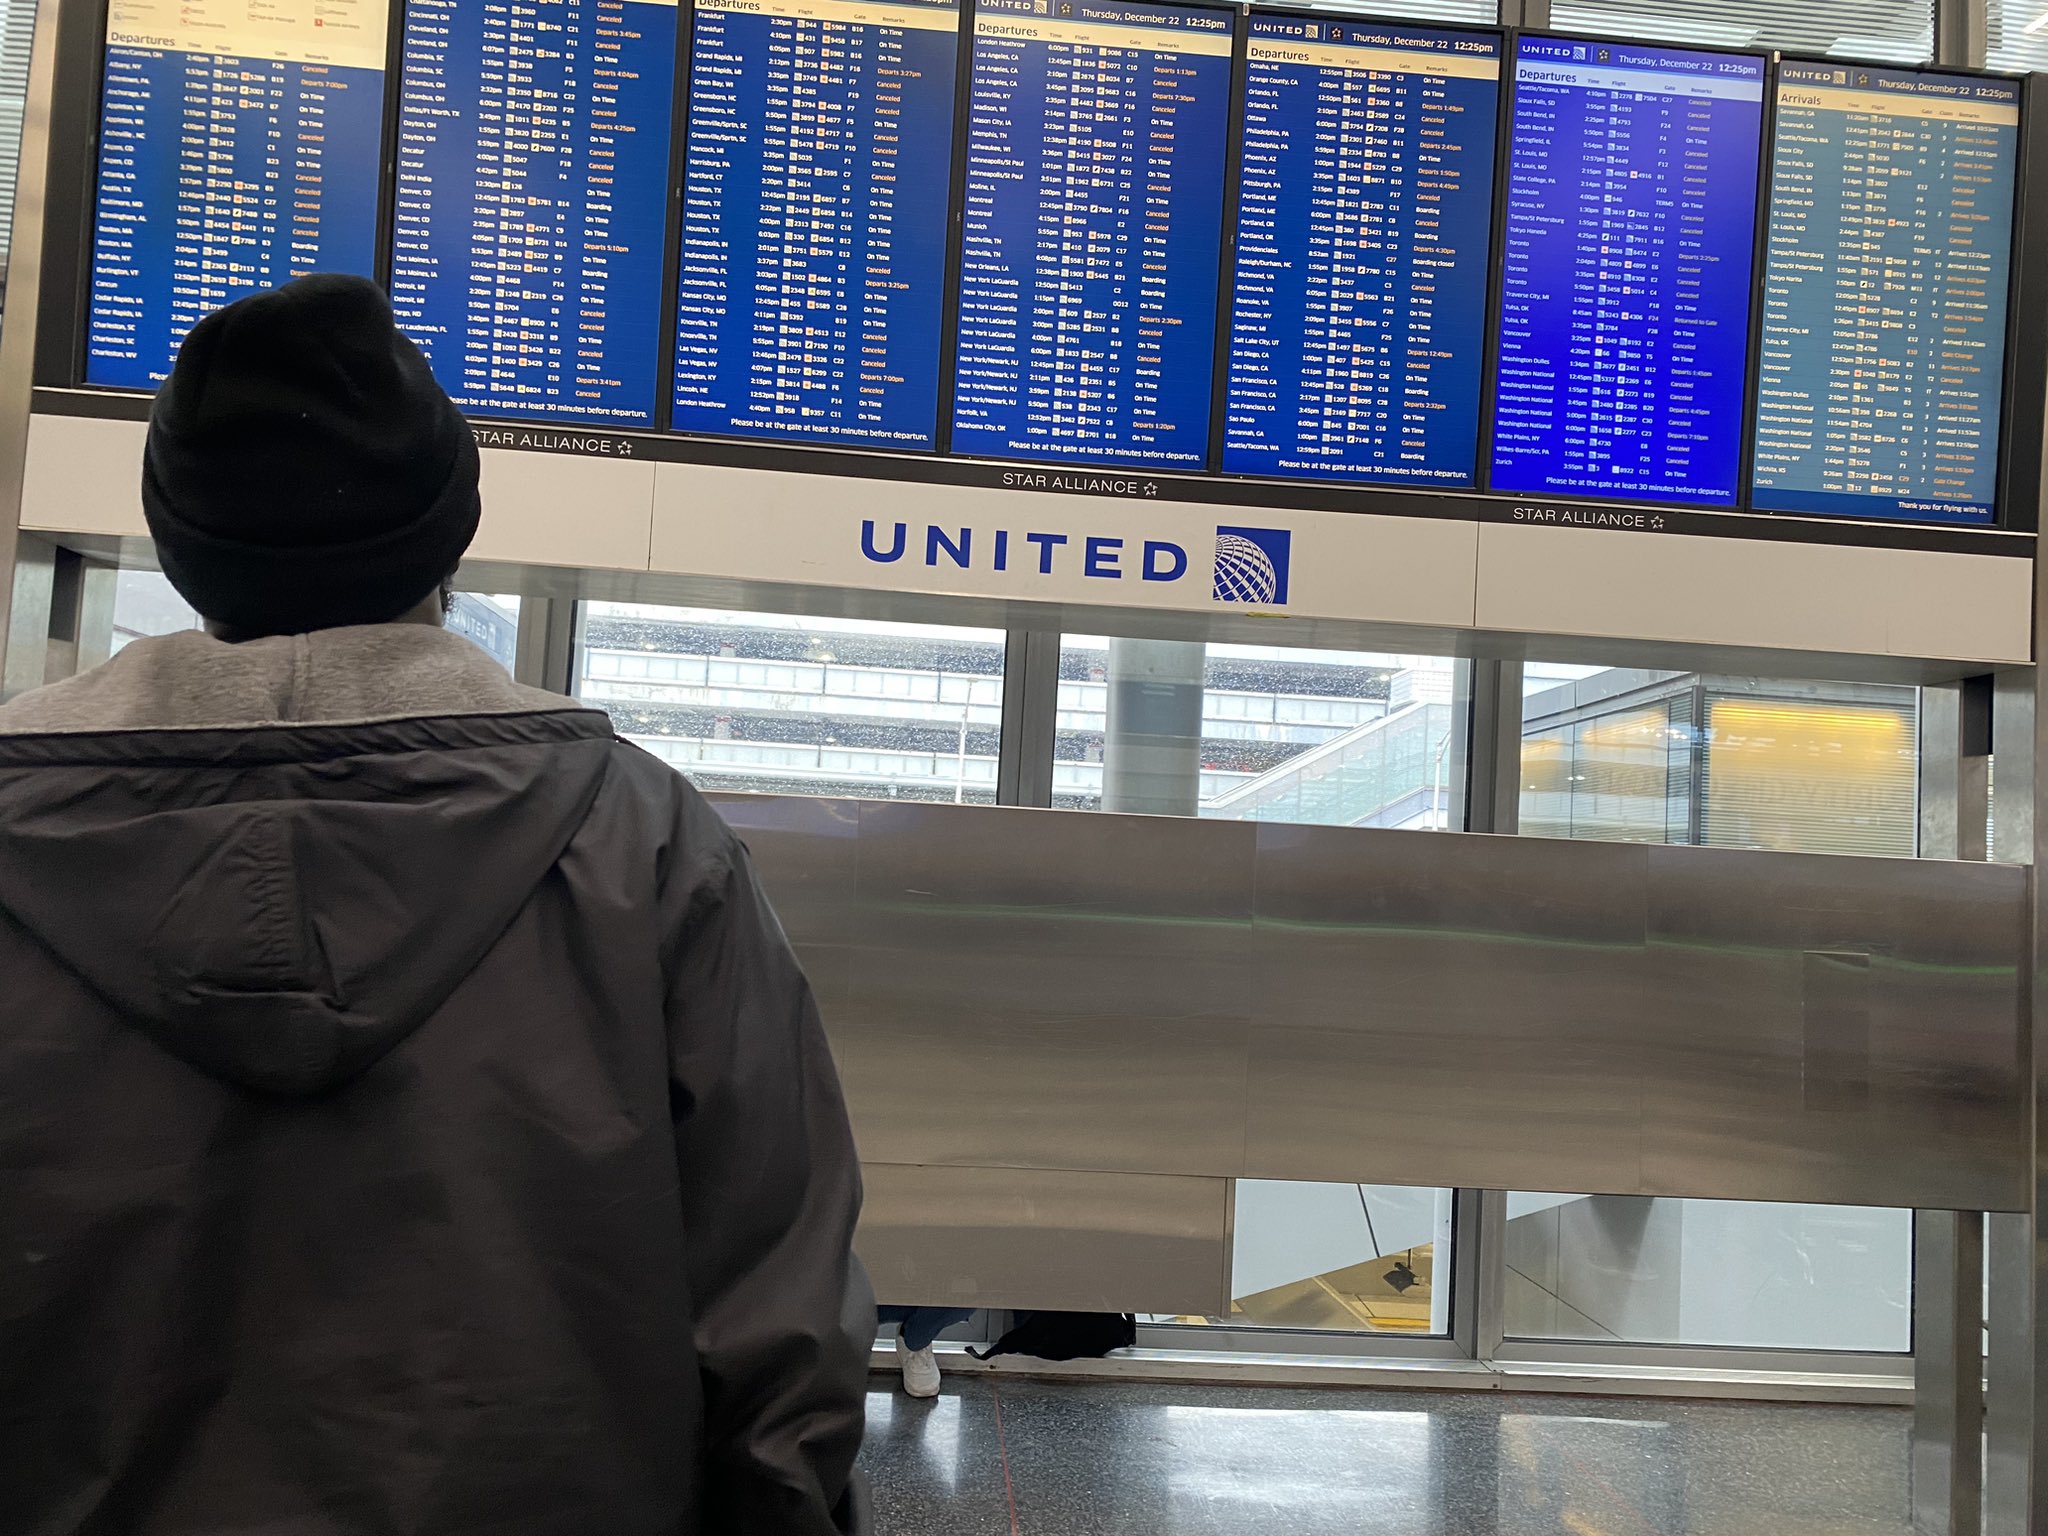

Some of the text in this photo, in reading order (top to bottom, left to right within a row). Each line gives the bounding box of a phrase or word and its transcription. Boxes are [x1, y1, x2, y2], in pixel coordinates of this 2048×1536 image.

[981, 0, 1031, 10] UNITED
[697, 11, 725, 20] Frankfurt
[1081, 8, 1225, 29] Thursday, December 22 12:25pm
[978, 22, 1038, 37] Departures
[1253, 23, 1303, 34] UNITED
[111, 32, 175, 47] Departures
[1351, 32, 1493, 53] Thursday, December 22 12:25pm
[1251, 47, 1310, 61] Departures
[1522, 45, 1571, 56] UNITED
[1619, 55, 1757, 75] Thursday, December 22 12:25pm
[1248, 75, 1269, 83] Orange
[1519, 69, 1577, 83] Departures
[1783, 69, 1831, 81] UNITED
[694, 78, 712, 86] Green
[876, 81, 901, 89] Canceled
[1152, 79, 1177, 87] Canceled
[1877, 78, 2012, 99] Thursday, December 22 12:25pm
[1152, 92, 1195, 102] Departs 7:30pm
[1781, 93, 1821, 105] Arrivals
[1511, 187, 1540, 195] Stockholm
[968, 196, 993, 204] Montreal
[990, 277, 1019, 286] LaGuardia
[1141, 276, 1166, 285] Boarding
[682, 291, 702, 299] Kansas
[1503, 329, 1531, 337] Vancouver
[1502, 342, 1521, 350] Vienna
[575, 376, 621, 386] Departs 3:41pm
[1500, 381, 1554, 391] Washington National
[469, 397, 479, 405] be
[488, 399, 501, 407] the
[501, 400, 518, 408] gate
[518, 401, 527, 409] at
[527, 401, 545, 410] least
[546, 403, 557, 411] 30
[557, 404, 586, 413] minutes
[586, 406, 610, 415] before
[611, 408, 647, 418] departure.
[730, 417, 754, 427] Please
[754, 419, 764, 427] be
[773, 421, 786, 429] the
[786, 423, 802, 431] gate
[811, 424, 829, 433] least
[829, 426, 840, 434] 30
[840, 427, 869, 436] minutes
[869, 429, 892, 438] before
[892, 431, 928, 441] departure.
[955, 421, 984, 430] Oklahoma
[519, 433, 611, 453] ALLIANCE
[1008, 440, 1031, 449] Please
[1031, 442, 1041, 450] be
[1050, 443, 1062, 451] the
[1062, 445, 1078, 453] gate
[1086, 446, 1103, 454] least
[1104, 447, 1114, 455] 30
[1114, 448, 1142, 457] minutes
[1142, 450, 1165, 458] before
[1165, 451, 1200, 461] departure.
[1278, 459, 1300, 468] Please
[1301, 461, 1310, 469] be
[1319, 462, 1331, 470] the
[1355, 464, 1372, 472] least
[1373, 465, 1383, 473] 30
[1383, 466, 1410, 475] minutes
[1410, 468, 1433, 476] before
[1433, 469, 1467, 478] departure.
[1002, 472, 1137, 494] STAR ALLIANCE
[1545, 476, 1567, 485] Please
[1586, 479, 1597, 487] the
[1621, 481, 1637, 489] least
[1648, 484, 1674, 492] minutes
[1675, 485, 1697, 494] before
[1697, 487, 1730, 496] departure.
[1897, 501, 1918, 509] Thank
[1931, 503, 1942, 511] for
[1942, 504, 1962, 513] flying
[1513, 507, 1644, 527] STAR ALLIANCE
[861, 519, 1188, 581] UNITED
